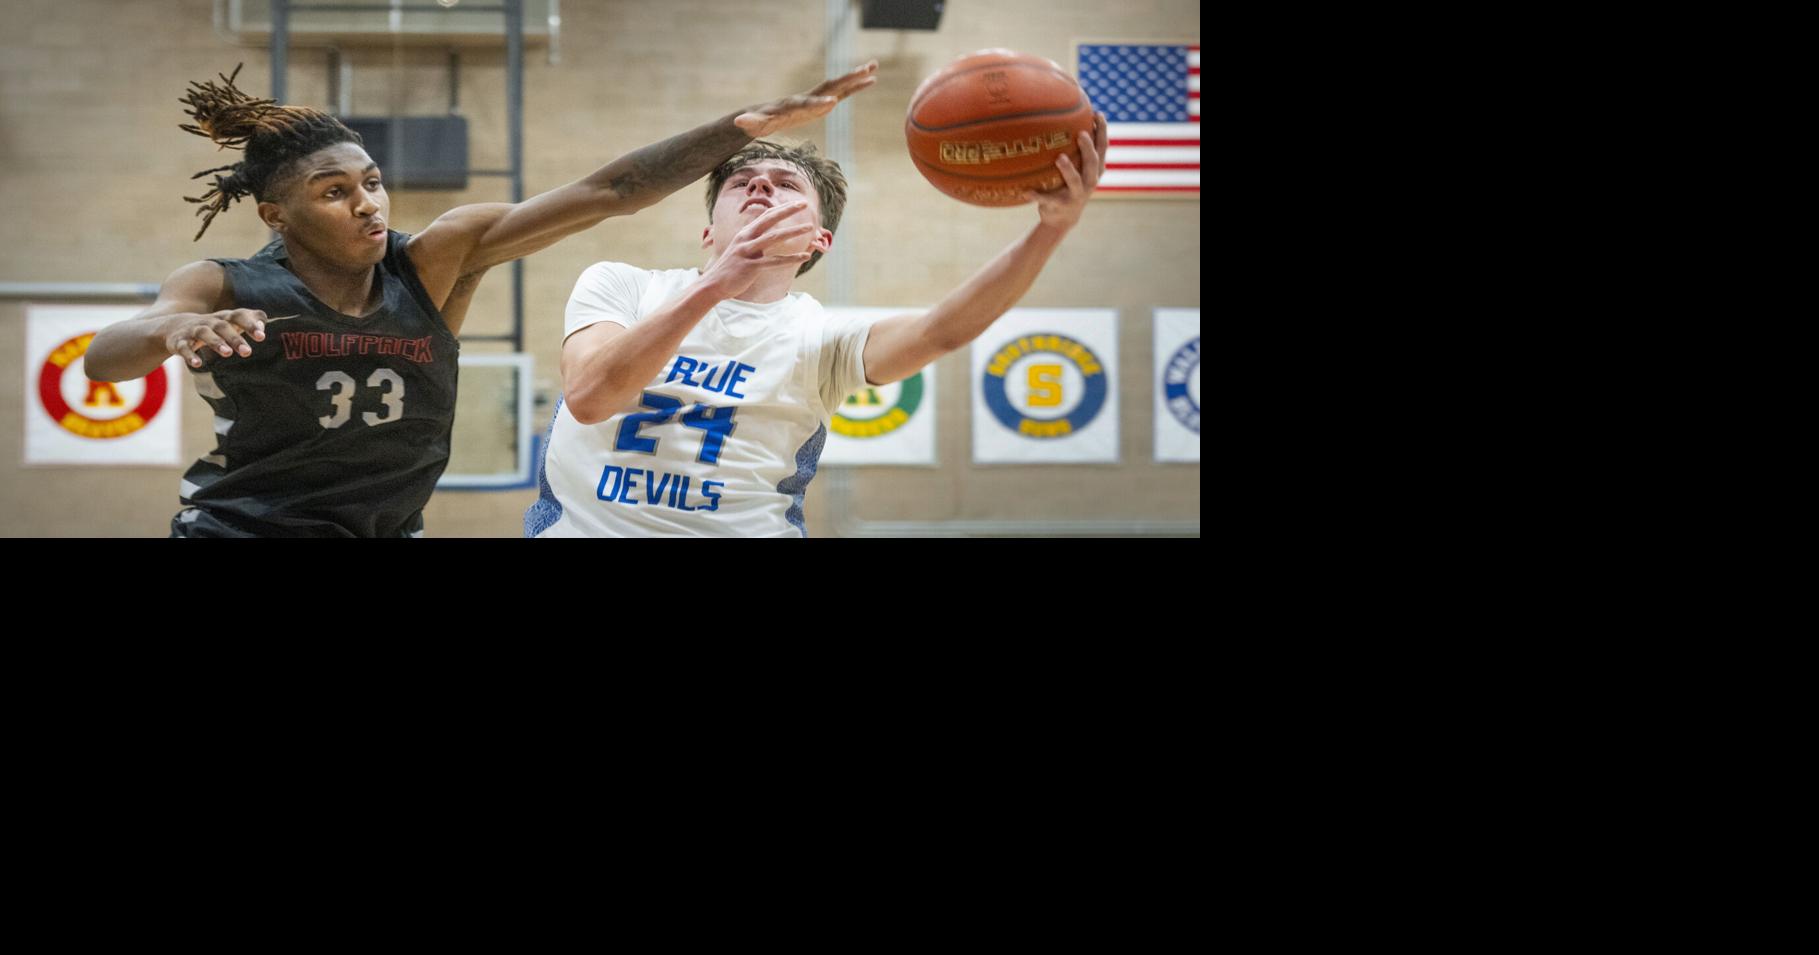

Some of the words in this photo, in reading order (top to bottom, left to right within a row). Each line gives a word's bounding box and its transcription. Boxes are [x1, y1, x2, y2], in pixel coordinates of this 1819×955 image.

[280, 331, 434, 364] WOLFPACK
[315, 368, 405, 429] 33
[1026, 363, 1064, 408] S
[612, 389, 738, 467] 24
[596, 465, 724, 512] DEVILS
